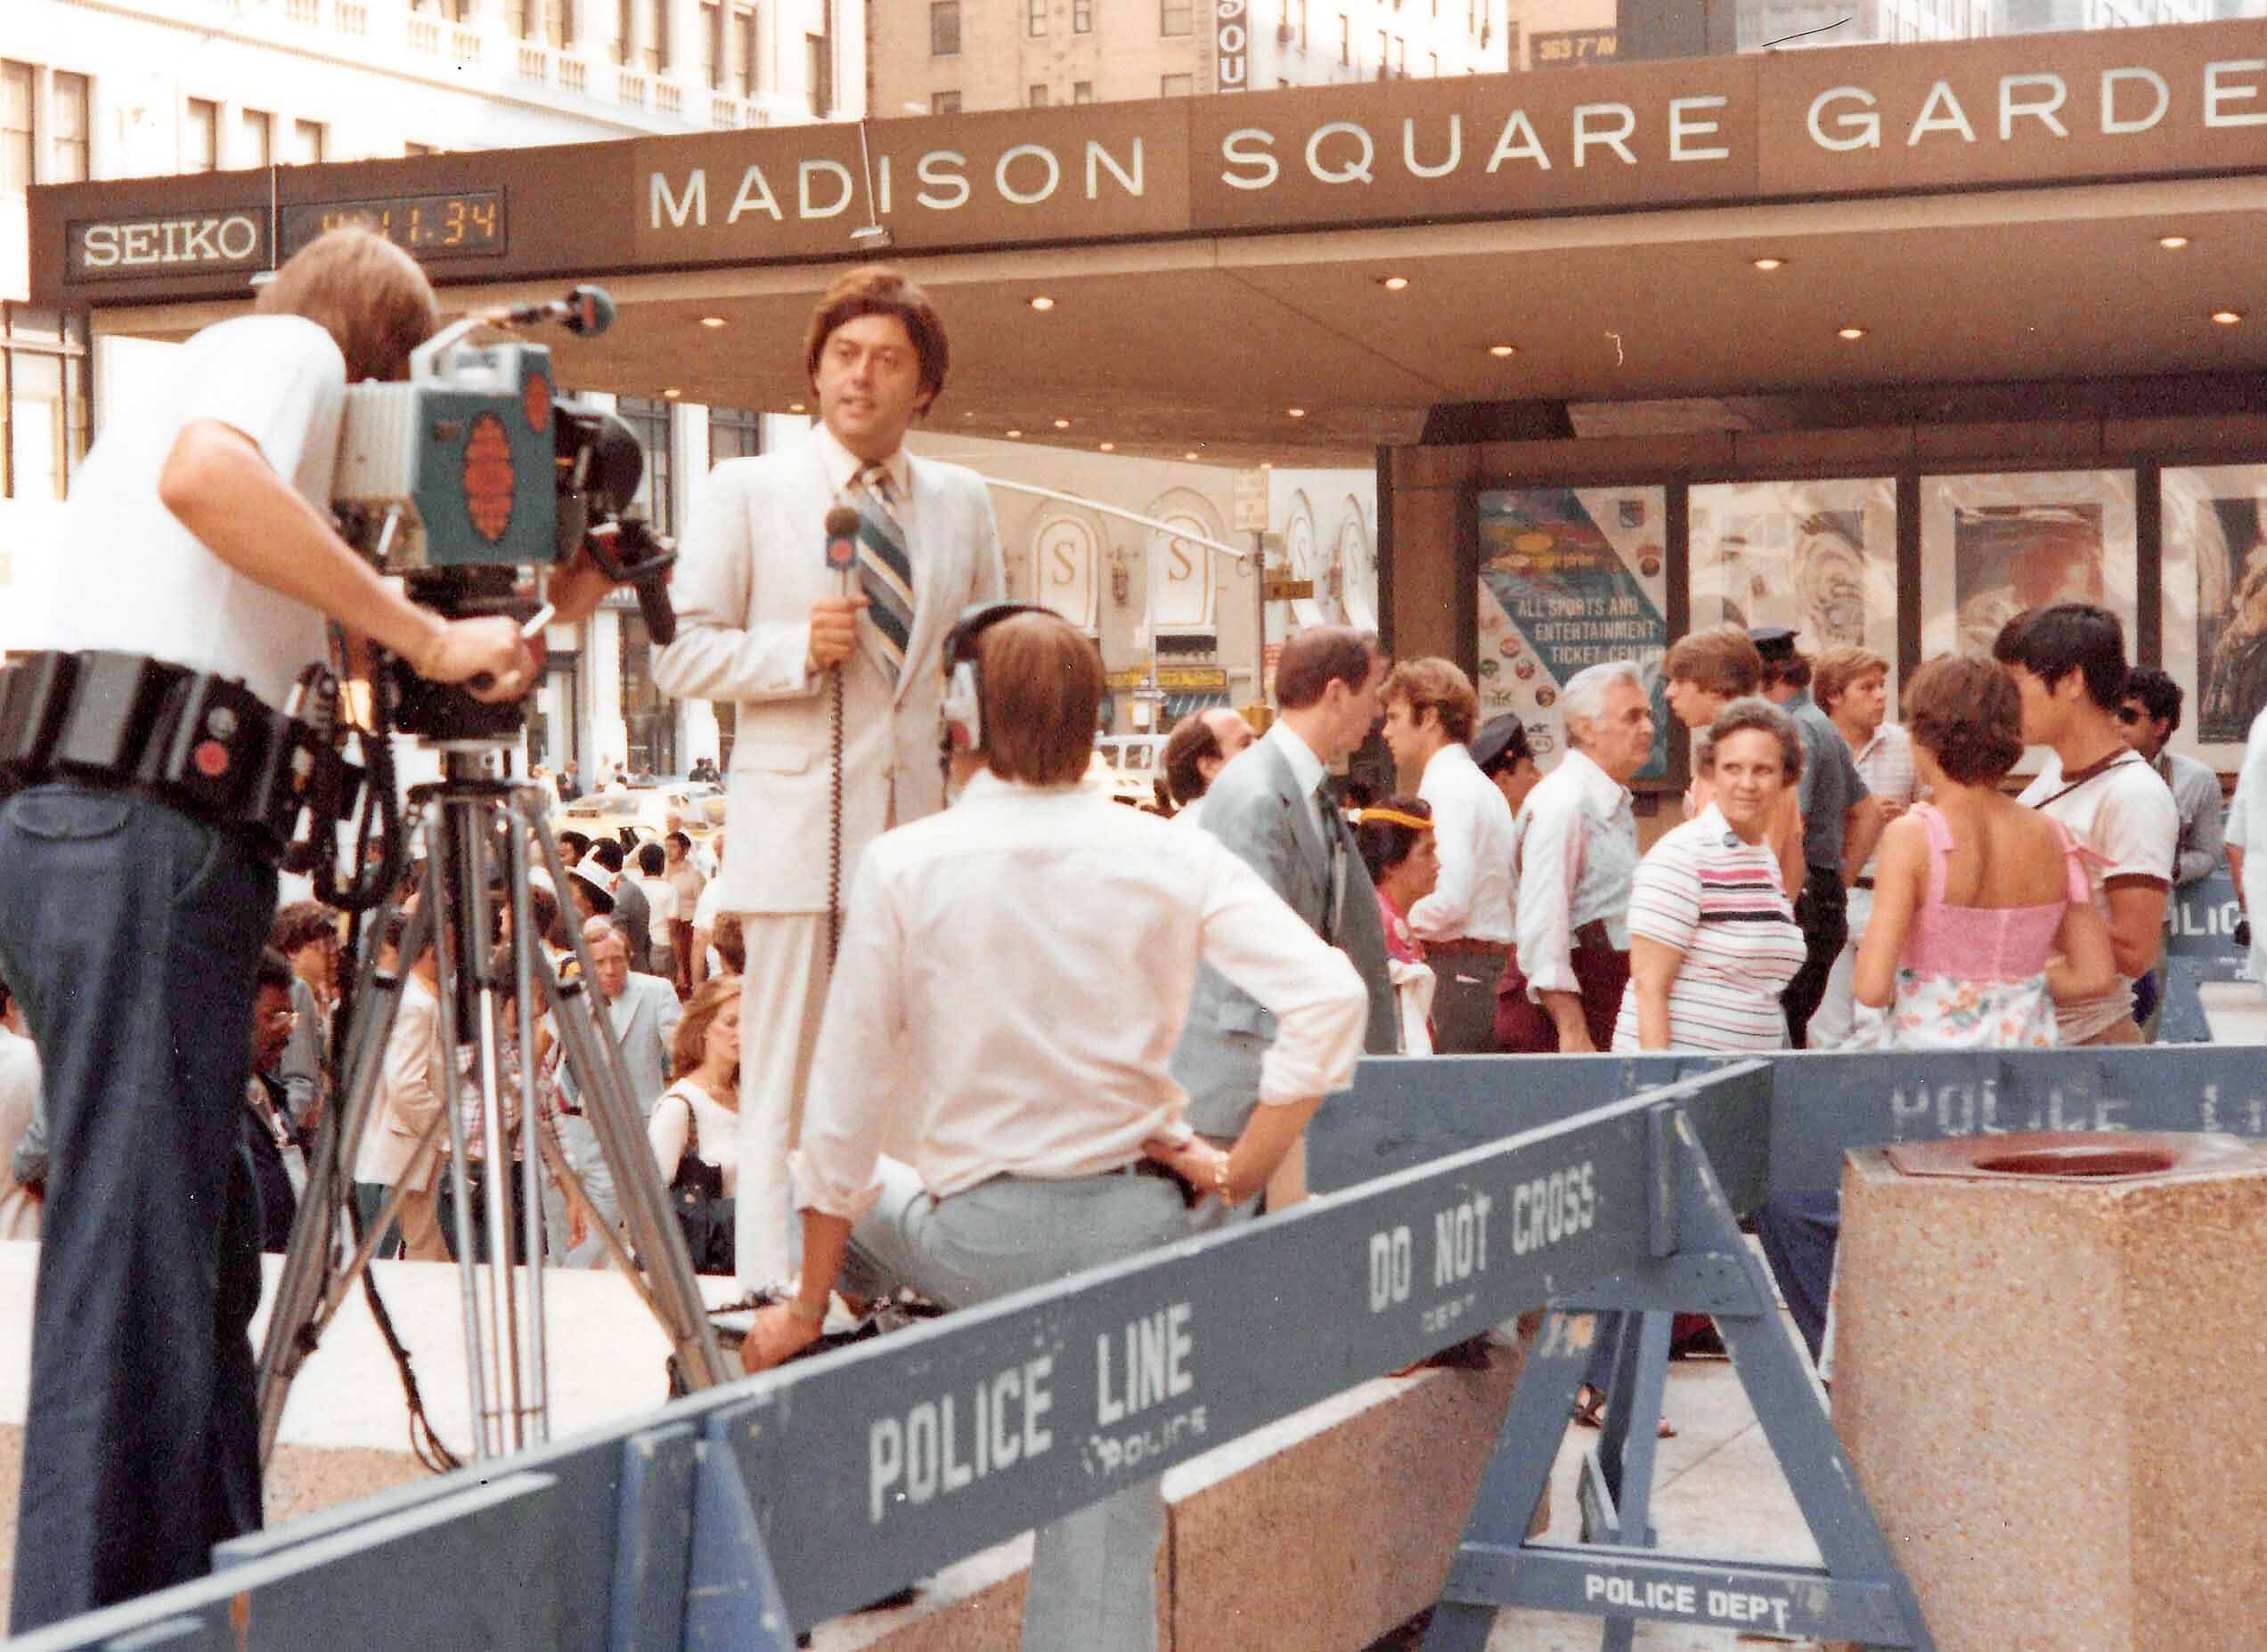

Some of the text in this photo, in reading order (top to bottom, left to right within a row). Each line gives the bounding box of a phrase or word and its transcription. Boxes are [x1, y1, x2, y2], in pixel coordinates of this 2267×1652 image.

[1218, 0, 1245, 92] SOU
[650, 58, 2267, 228] MADISON SQUARE GARDE
[85, 216, 257, 266] SEIKO
[1053, 541, 1076, 584] S
[1169, 535, 1192, 583] S
[1518, 598, 1541, 617] ALL
[1609, 598, 1639, 615] AND
[1534, 620, 1654, 642] ENTERTAINMENT
[1369, 1160, 1594, 1314] DO NOT CROSS
[869, 1301, 1195, 1524] POLICE LINE
[1585, 1574, 1791, 1633] POLICE DEPT
